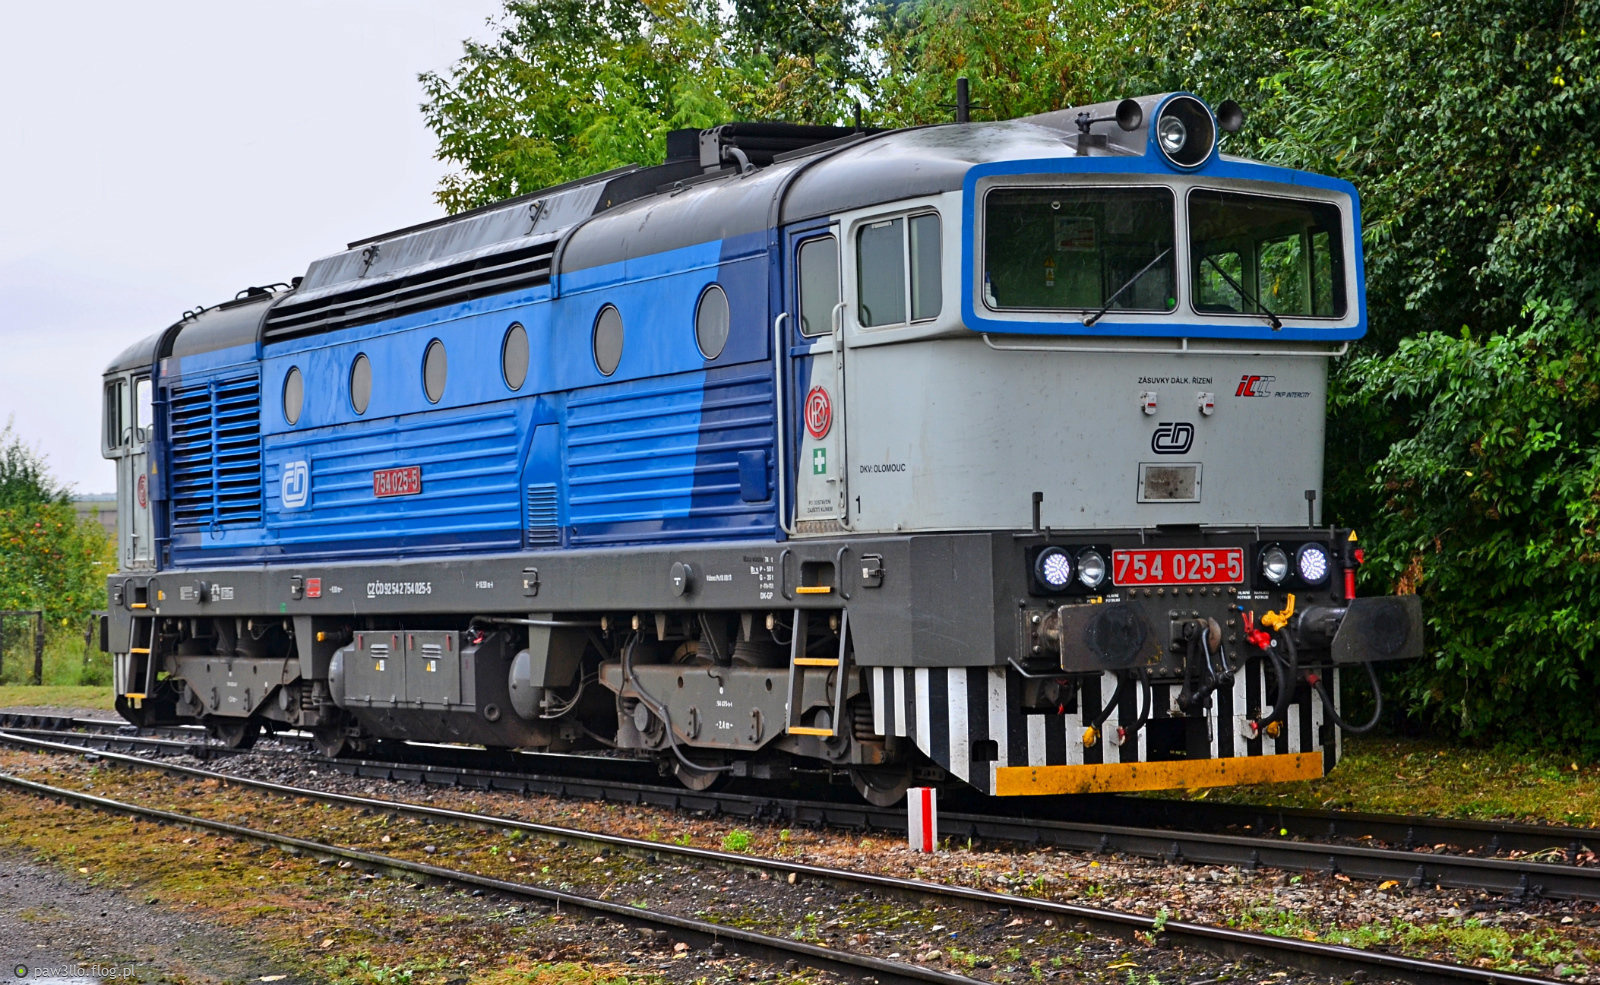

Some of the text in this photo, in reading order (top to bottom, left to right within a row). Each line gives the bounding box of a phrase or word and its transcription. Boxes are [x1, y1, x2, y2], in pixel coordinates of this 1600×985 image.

[1137, 375, 1169, 384] ZÁSUVKY
[873, 463, 906, 473] OLOMOUC
[375, 469, 418, 494] 754 025-5
[1116, 552, 1241, 581] 754 025-5
[367, 582, 375, 596] CZ
[404, 582, 415, 594] 754
[415, 582, 432, 594] 025-5
